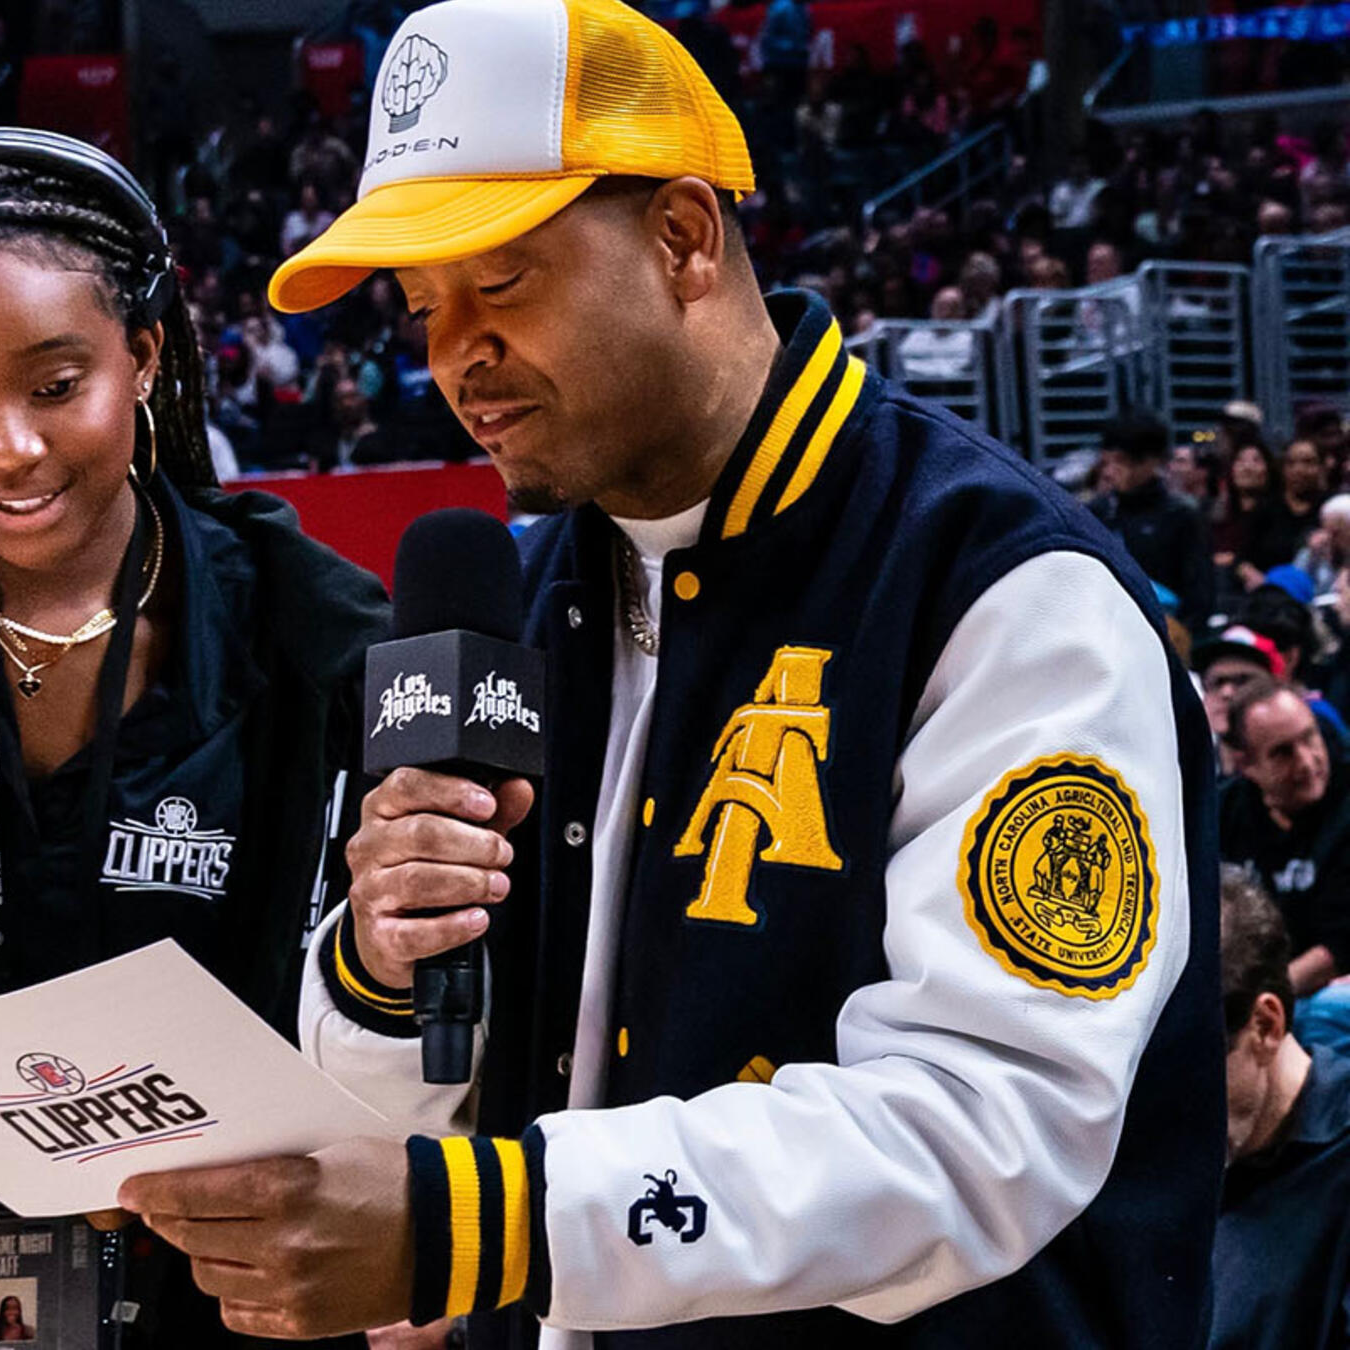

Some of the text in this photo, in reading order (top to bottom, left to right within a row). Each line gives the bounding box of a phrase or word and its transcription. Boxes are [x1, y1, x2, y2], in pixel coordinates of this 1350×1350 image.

[393, 671, 427, 697] Los
[464, 682, 541, 733] Angeles
[486, 670, 517, 700] Los
[370, 683, 452, 738] Angeles
[998, 795, 1050, 852] CAROLINA
[103, 830, 232, 888] CLIPPERS
[1120, 837, 1134, 864] AND
[994, 858, 1015, 906] NORTH
[1115, 872, 1138, 940] TECHNICAL
[1012, 917, 1052, 952] STATE
[1058, 939, 1115, 962] UNIVERSITY
[0, 1073, 208, 1154] CLIPPERS
[18, 1233, 54, 1255] NIGHT
